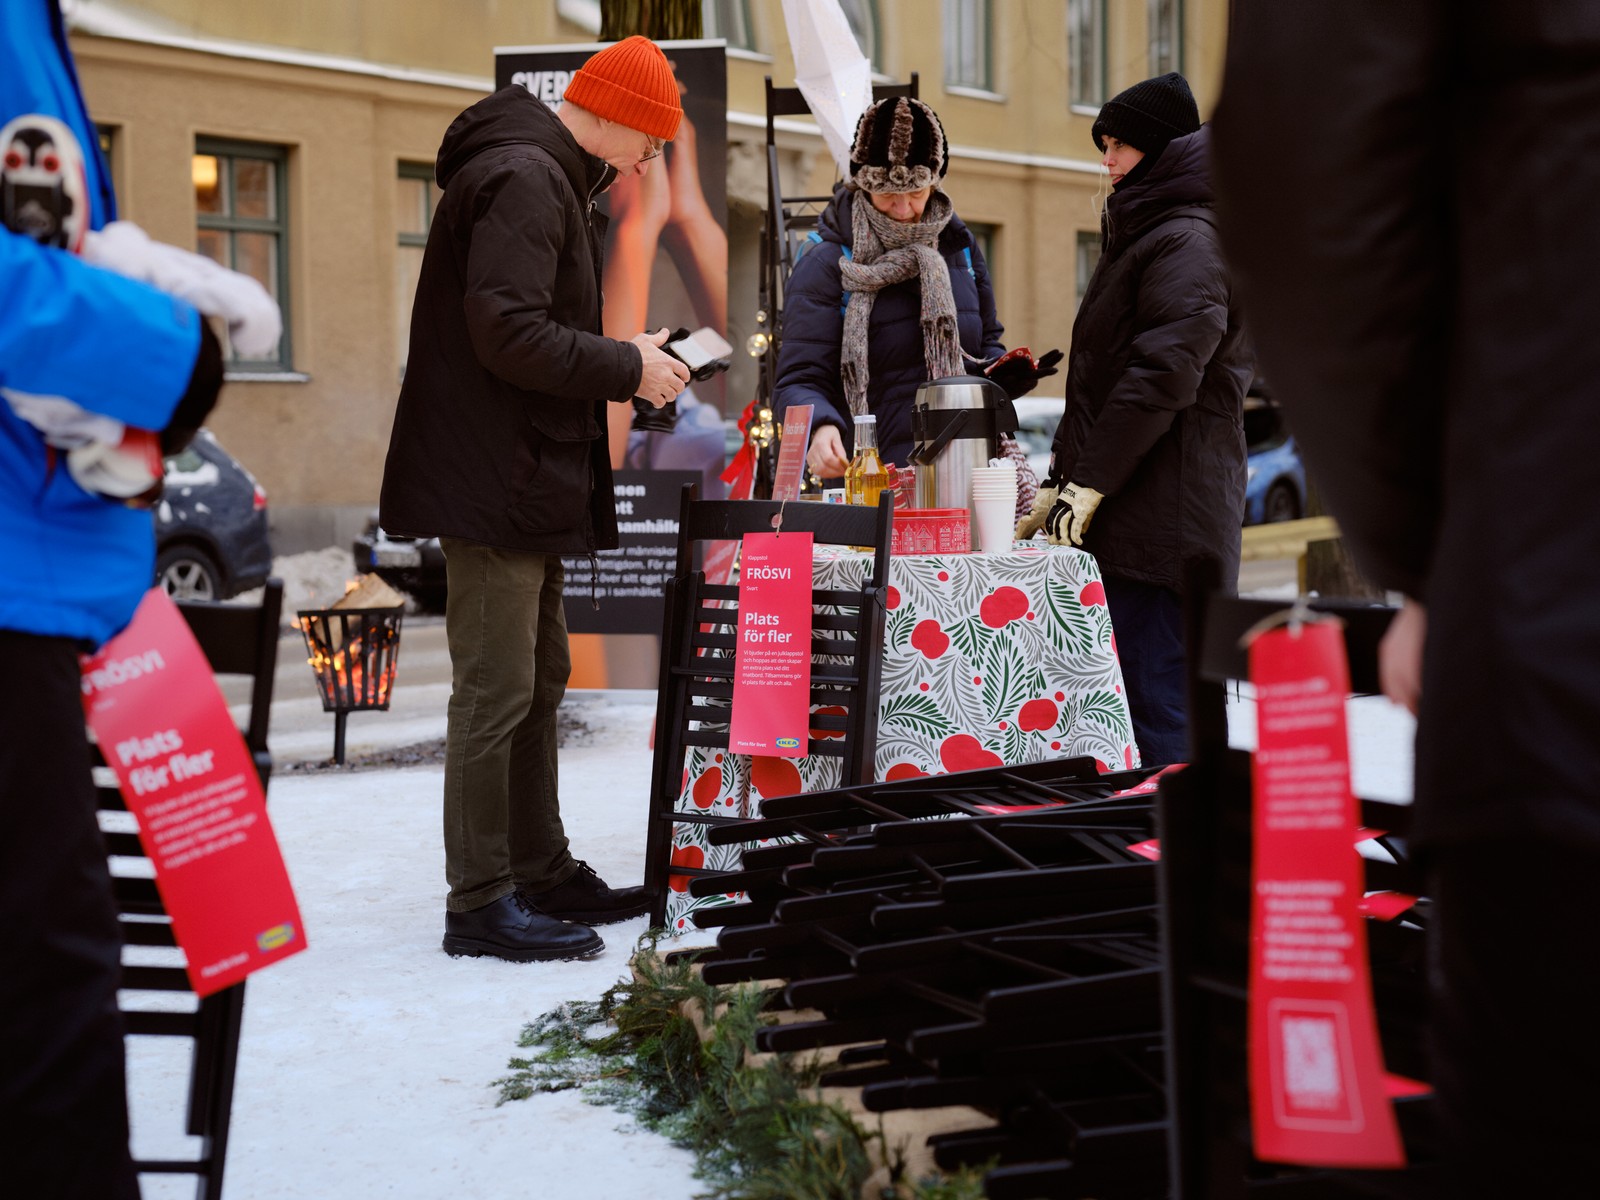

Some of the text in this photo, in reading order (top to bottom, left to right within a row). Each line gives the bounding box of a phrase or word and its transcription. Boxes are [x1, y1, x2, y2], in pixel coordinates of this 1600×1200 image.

[511, 70, 577, 101] SVER
[614, 485, 646, 497] nen
[746, 565, 791, 580] FRÖSVI
[745, 612, 780, 626] Plats
[744, 629, 793, 643] för fler
[115, 729, 183, 767] Plats
[129, 765, 170, 796] för
[169, 749, 214, 782] fler
